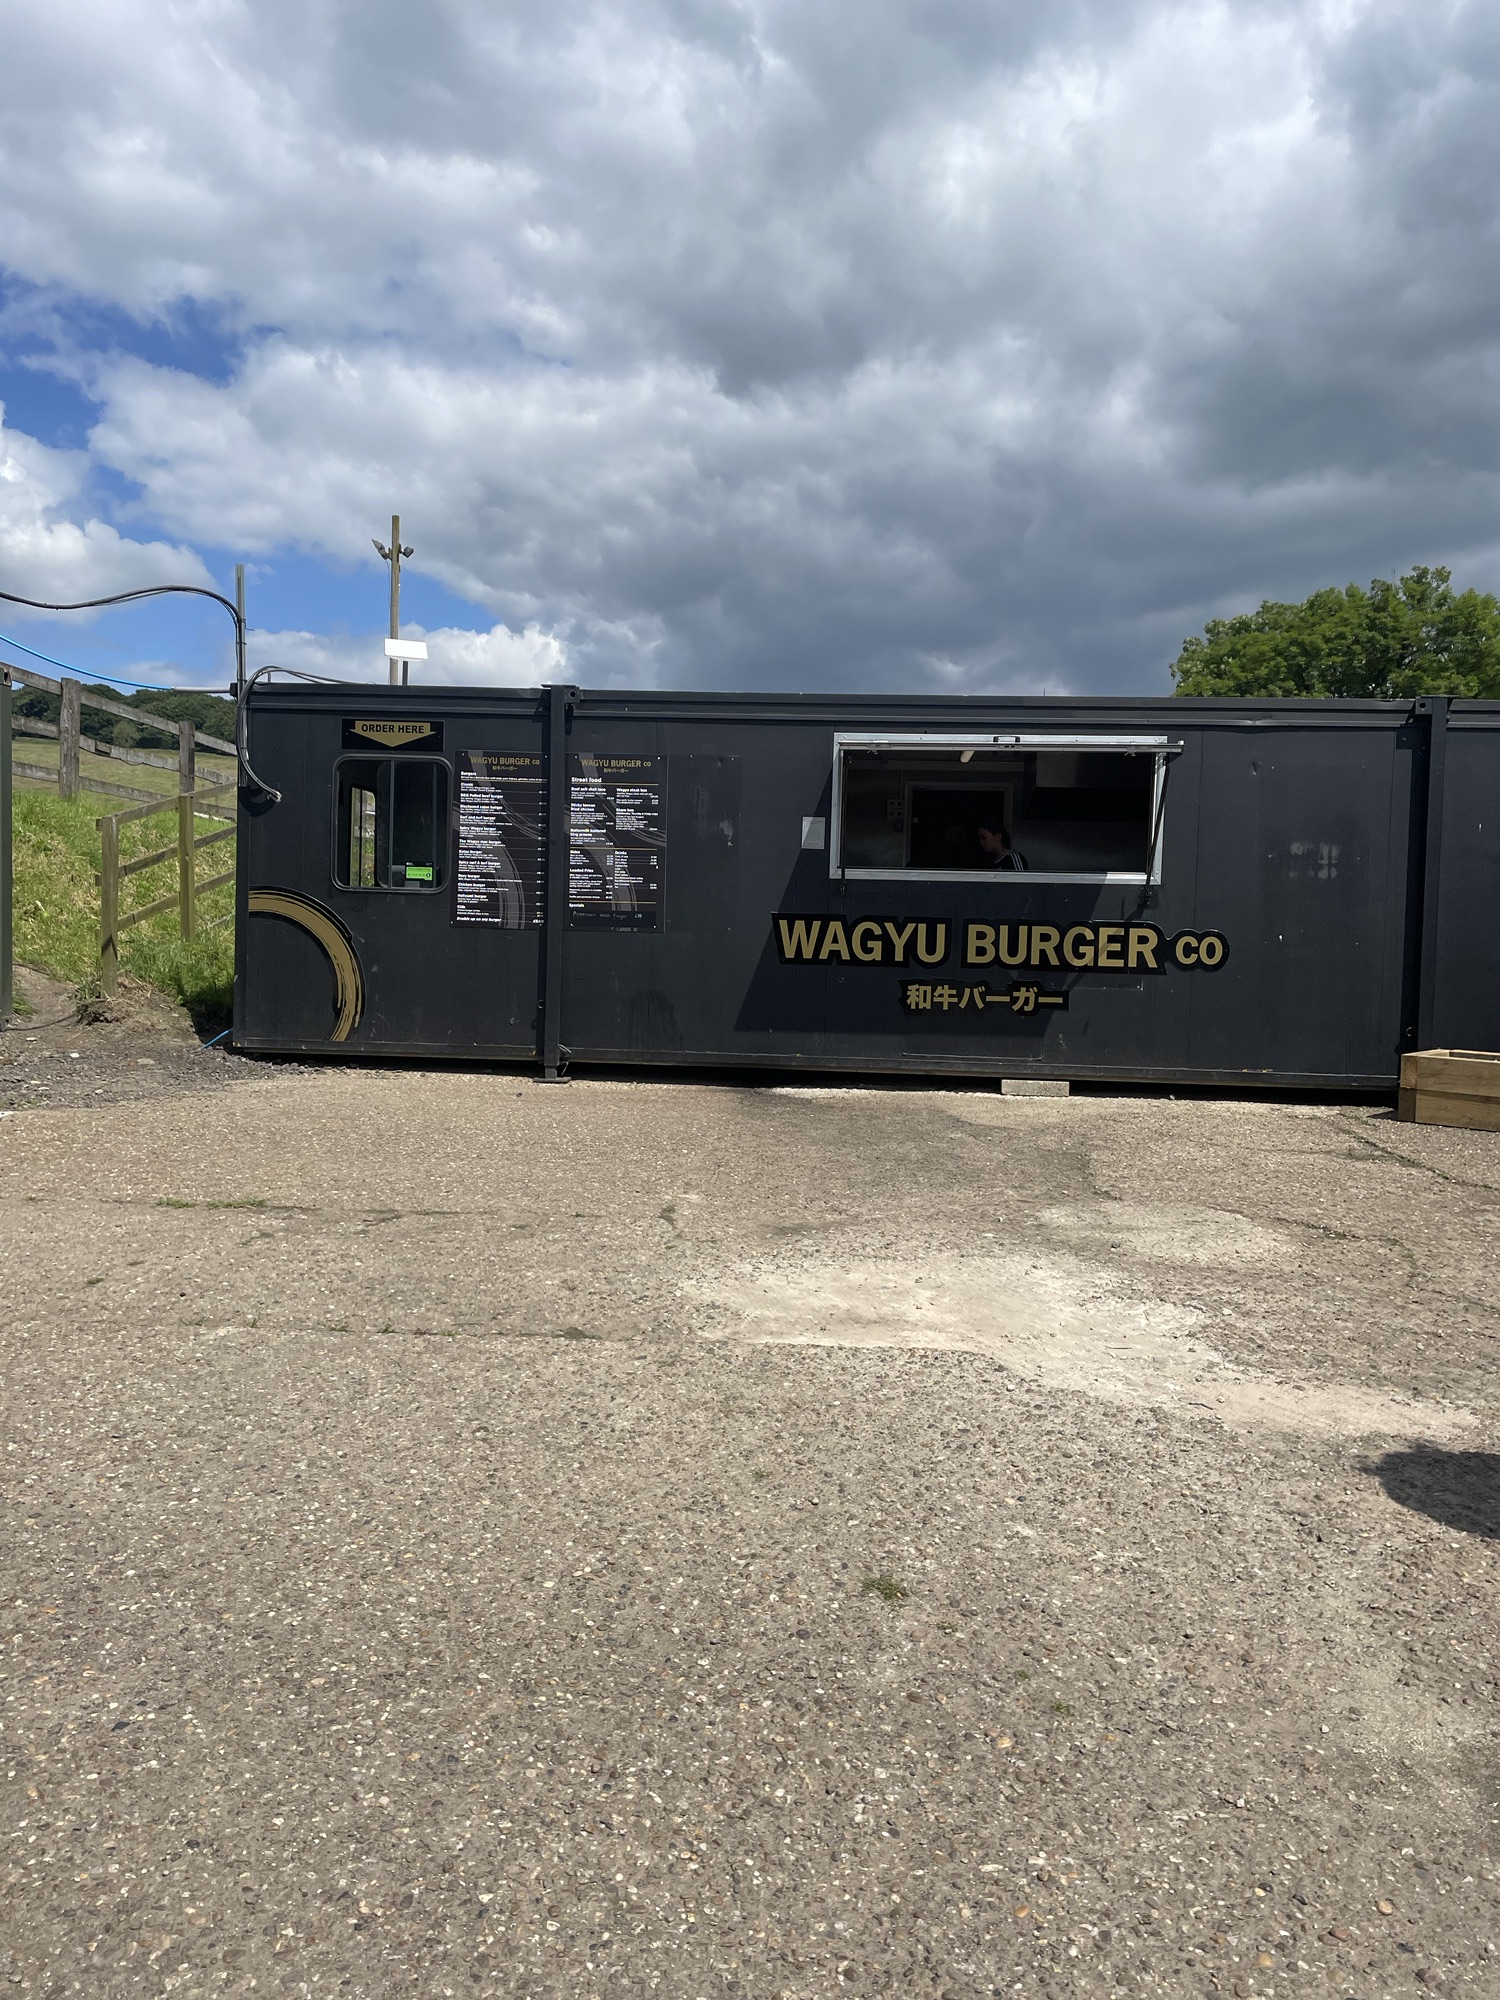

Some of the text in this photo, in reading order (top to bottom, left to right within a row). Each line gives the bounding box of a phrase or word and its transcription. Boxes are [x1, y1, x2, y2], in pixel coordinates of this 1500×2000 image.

[362, 723, 424, 733] ORDER HERE
[470, 756, 498, 765] WAGYU
[500, 757, 530, 765] BURGER
[581, 759, 608, 767] WAGYU
[611, 759, 642, 768] BURGER
[779, 920, 1223, 968] WAGYU BURGER CO
[906, 985, 1064, 1012] 和牛バーガー
